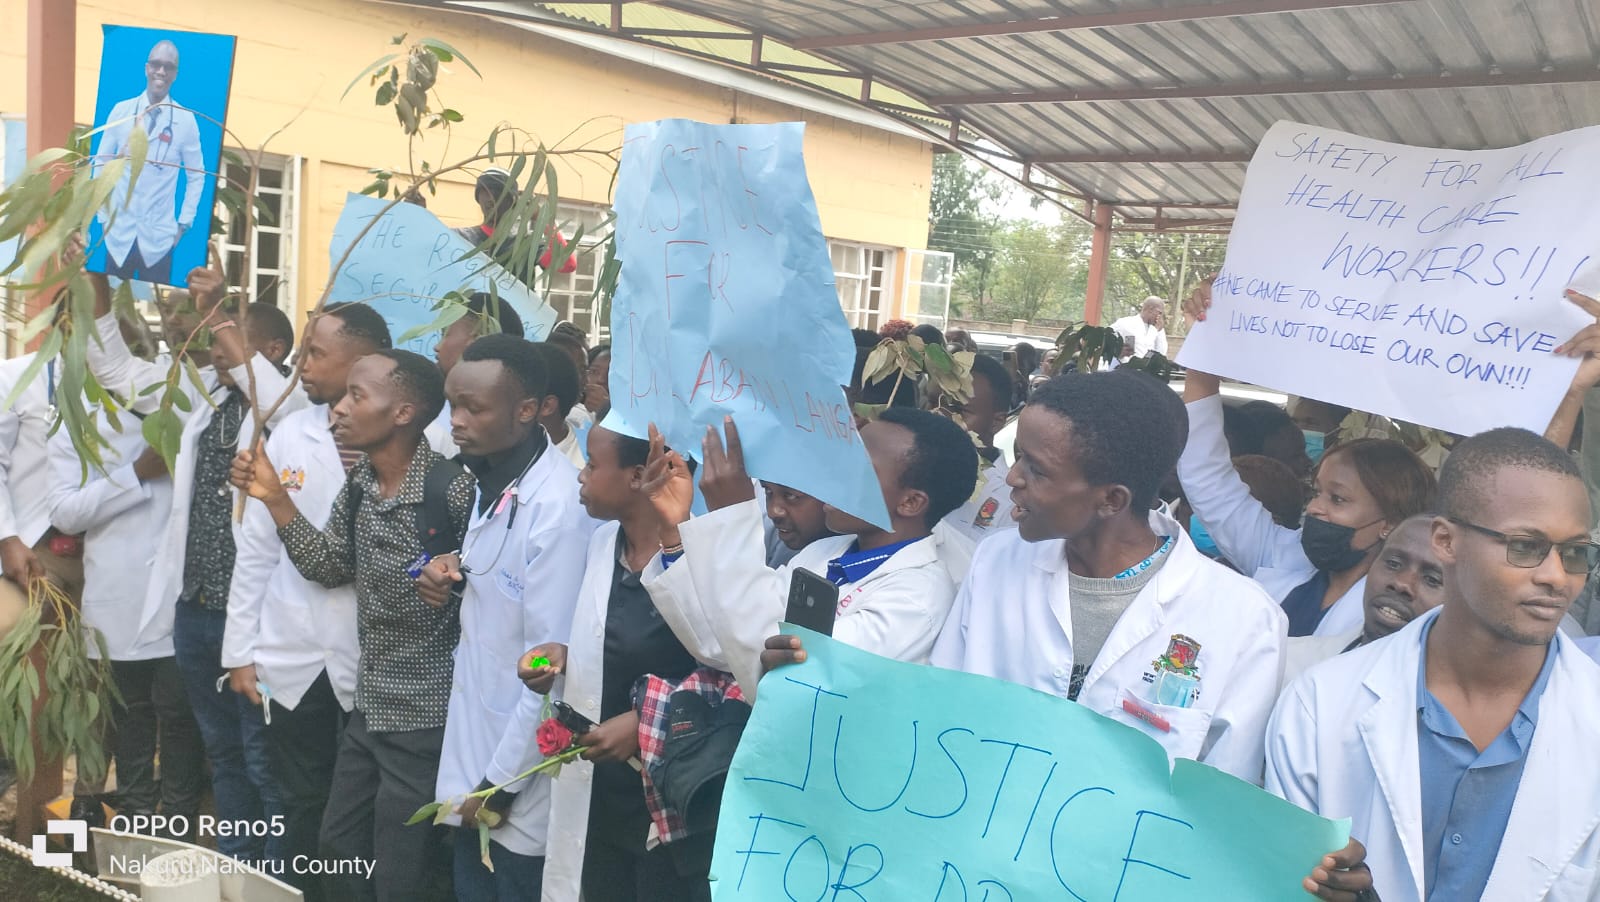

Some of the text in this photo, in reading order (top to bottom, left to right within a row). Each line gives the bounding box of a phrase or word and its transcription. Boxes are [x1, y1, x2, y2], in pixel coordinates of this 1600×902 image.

[1275, 132, 1565, 190] SAFETY FOR ALL
[356, 212, 407, 249] THE
[1284, 173, 1520, 234] HEALTH CARE
[1230, 310, 1532, 391] LIVES NOT TO LOSE OUR OWN!!!
[1246, 278, 1295, 303] CAME
[1299, 288, 1321, 310] TO
[1324, 295, 1399, 322] SERVE
[1403, 303, 1468, 335] AND
[1473, 321, 1557, 353] SAVE
[743, 676, 1195, 902] JUSTICE
[735, 812, 884, 902] FOR
